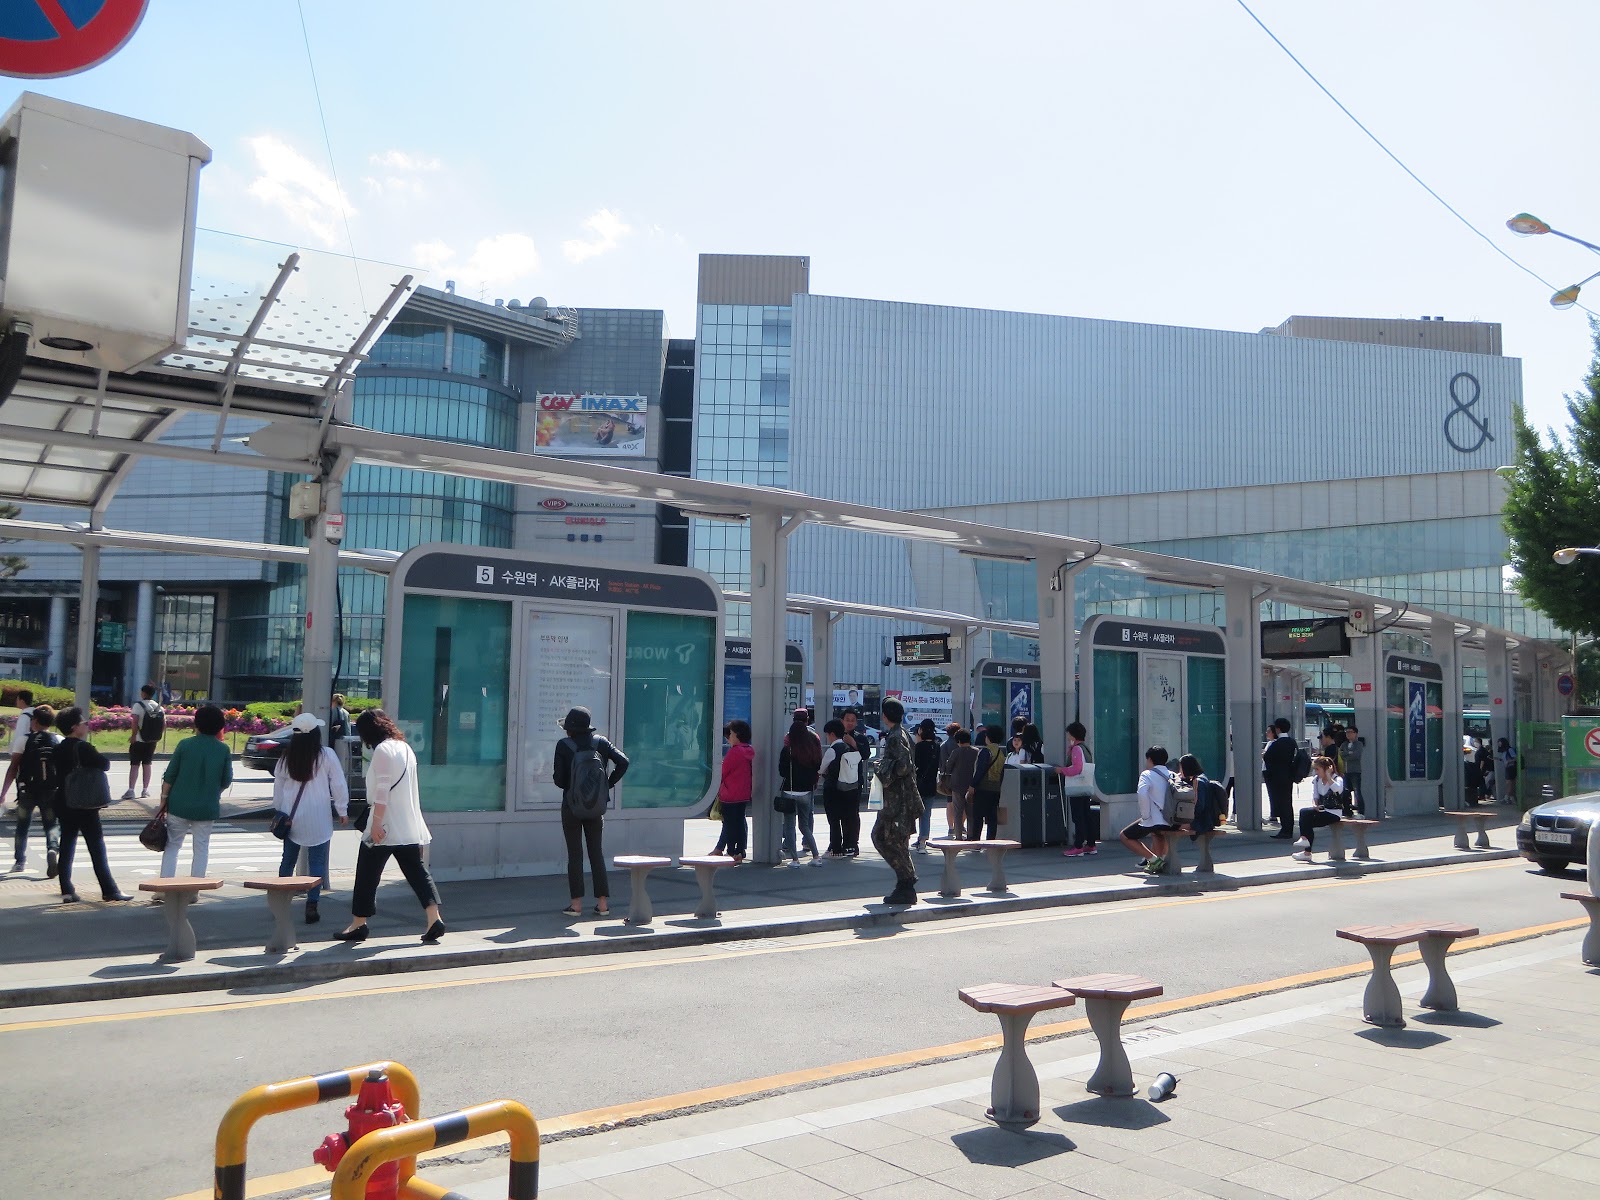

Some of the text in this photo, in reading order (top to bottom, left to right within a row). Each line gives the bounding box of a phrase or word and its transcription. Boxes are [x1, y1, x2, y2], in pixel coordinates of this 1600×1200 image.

[541, 396, 641, 411] CGV IMAX
[481, 568, 490, 582] 5
[501, 570, 537, 587] 수원역
[549, 575, 600, 591] AK플라자
[1132, 631, 1148, 642] 수원역
[1153, 633, 1175, 644] AK플라자
[1161, 686, 1175, 703] 수원
